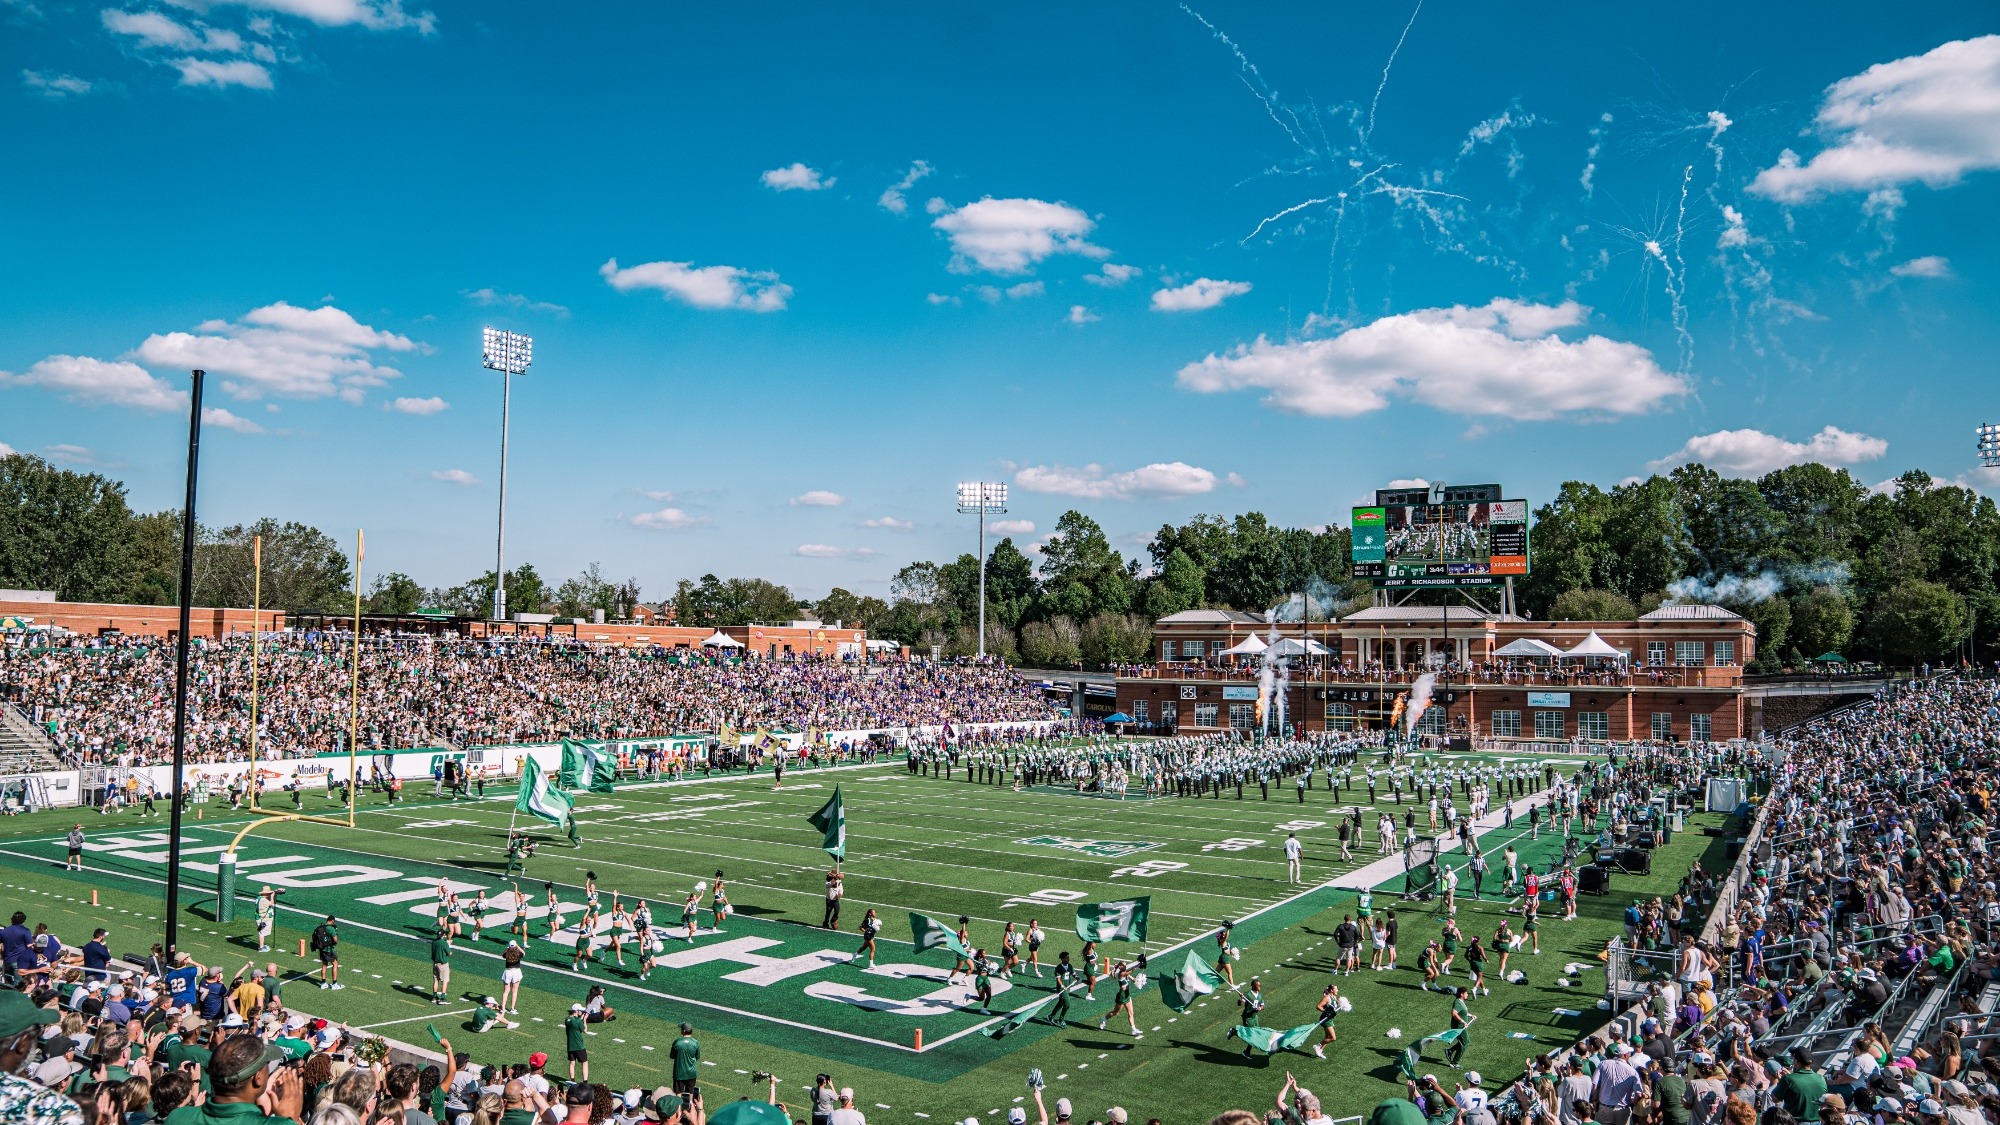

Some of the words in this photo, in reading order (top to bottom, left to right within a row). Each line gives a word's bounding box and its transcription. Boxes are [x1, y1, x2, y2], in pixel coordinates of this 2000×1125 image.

[1183, 687, 1194, 698] 25
[1201, 838, 1267, 851] 30
[1111, 860, 1190, 878] 20
[1003, 889, 1089, 908] 10
[170, 977, 187, 993] 22
[1471, 1097, 1482, 1109] 7
